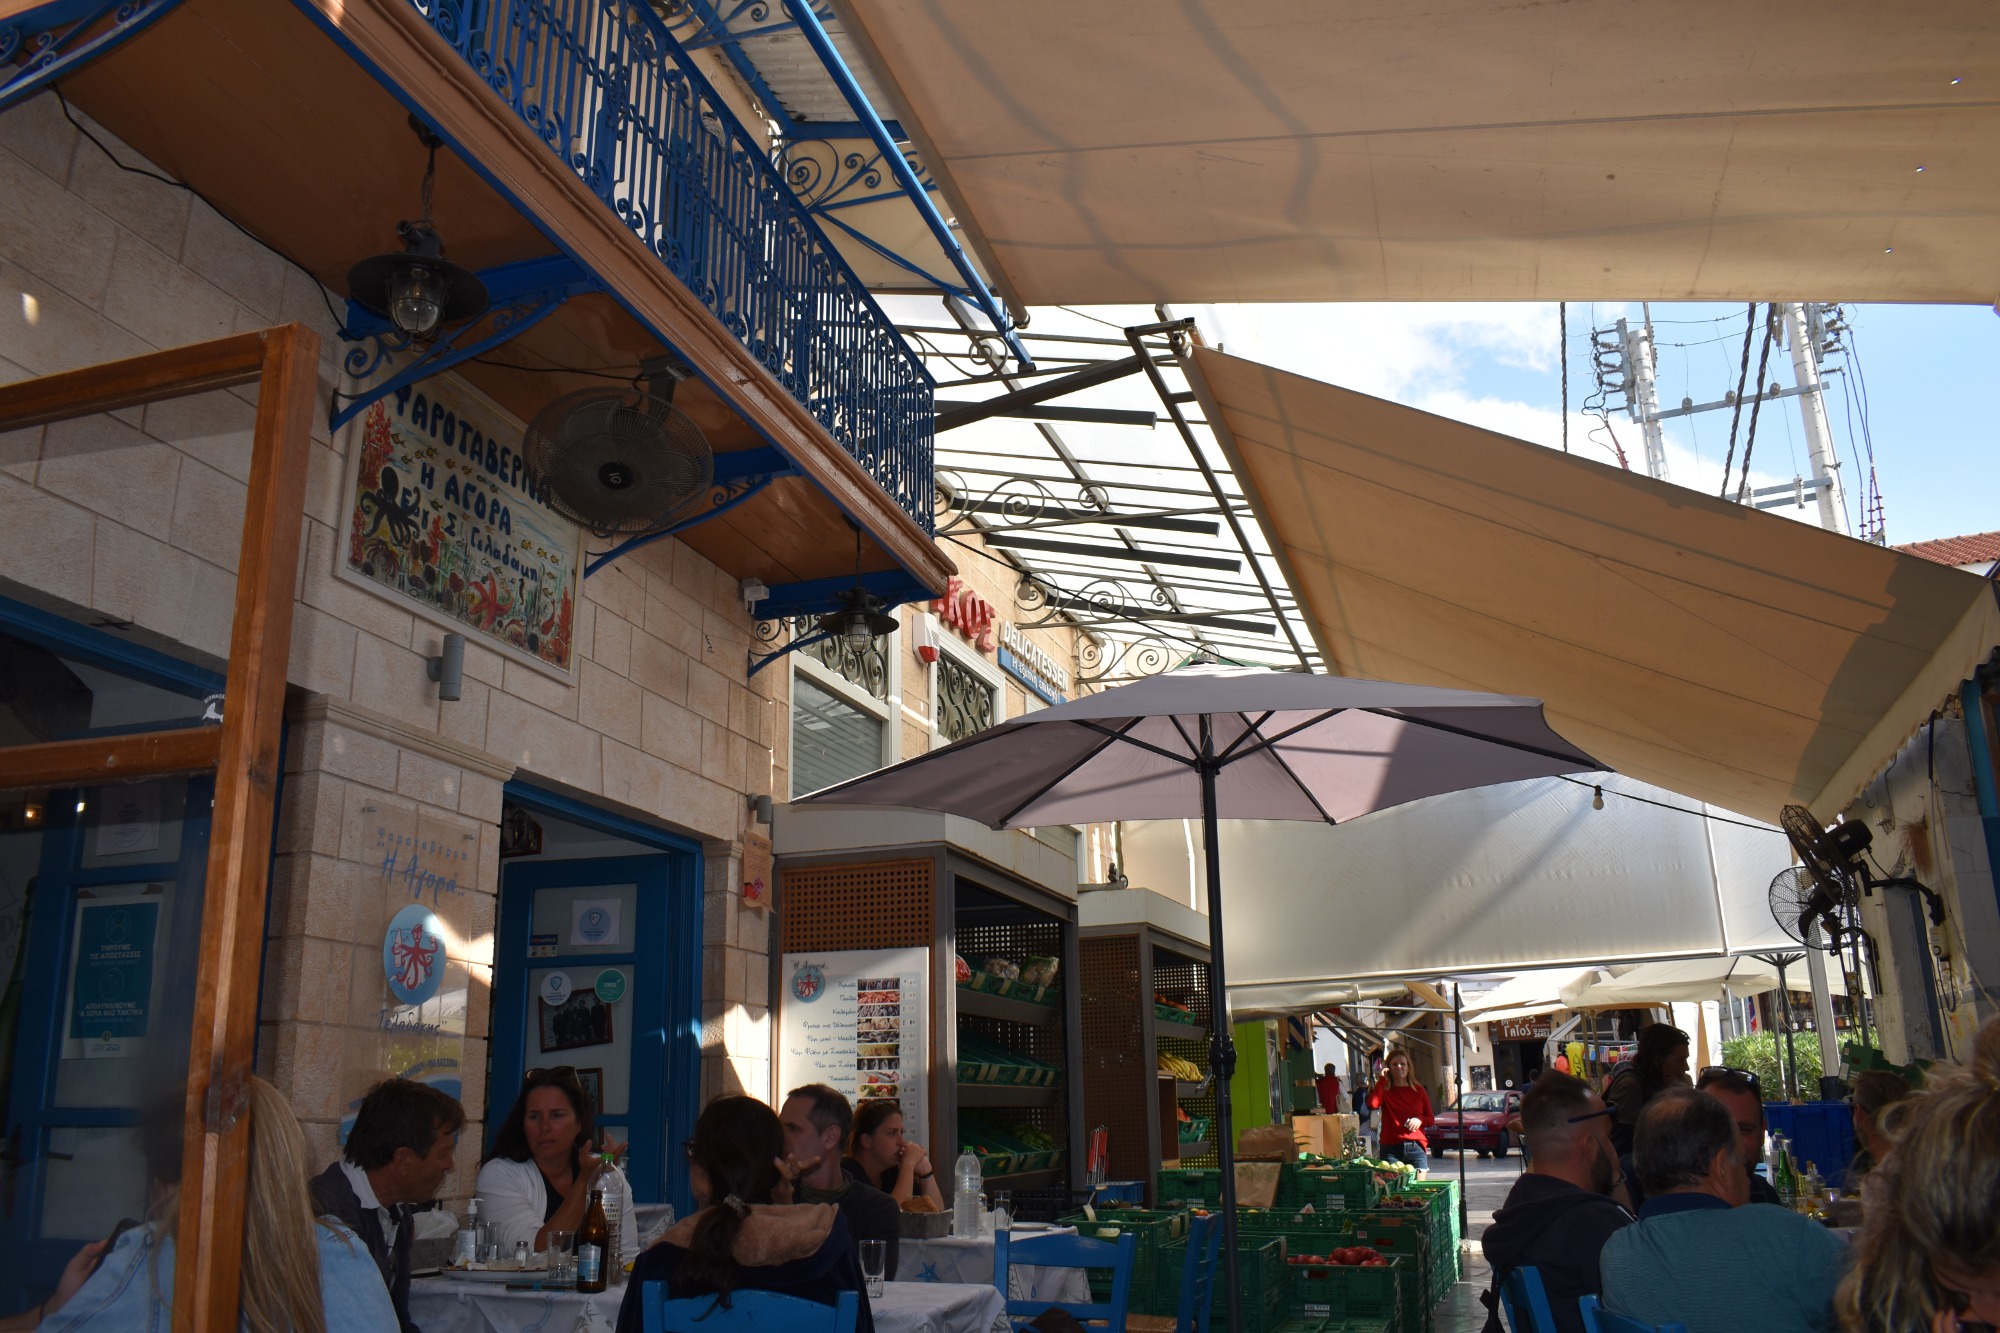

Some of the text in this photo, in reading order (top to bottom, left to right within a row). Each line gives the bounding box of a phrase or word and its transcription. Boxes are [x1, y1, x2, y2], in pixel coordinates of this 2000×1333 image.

[421, 462, 511, 536] Η ΑΓΟΡΑ
[1003, 619, 1069, 692] DELICATESSEN
